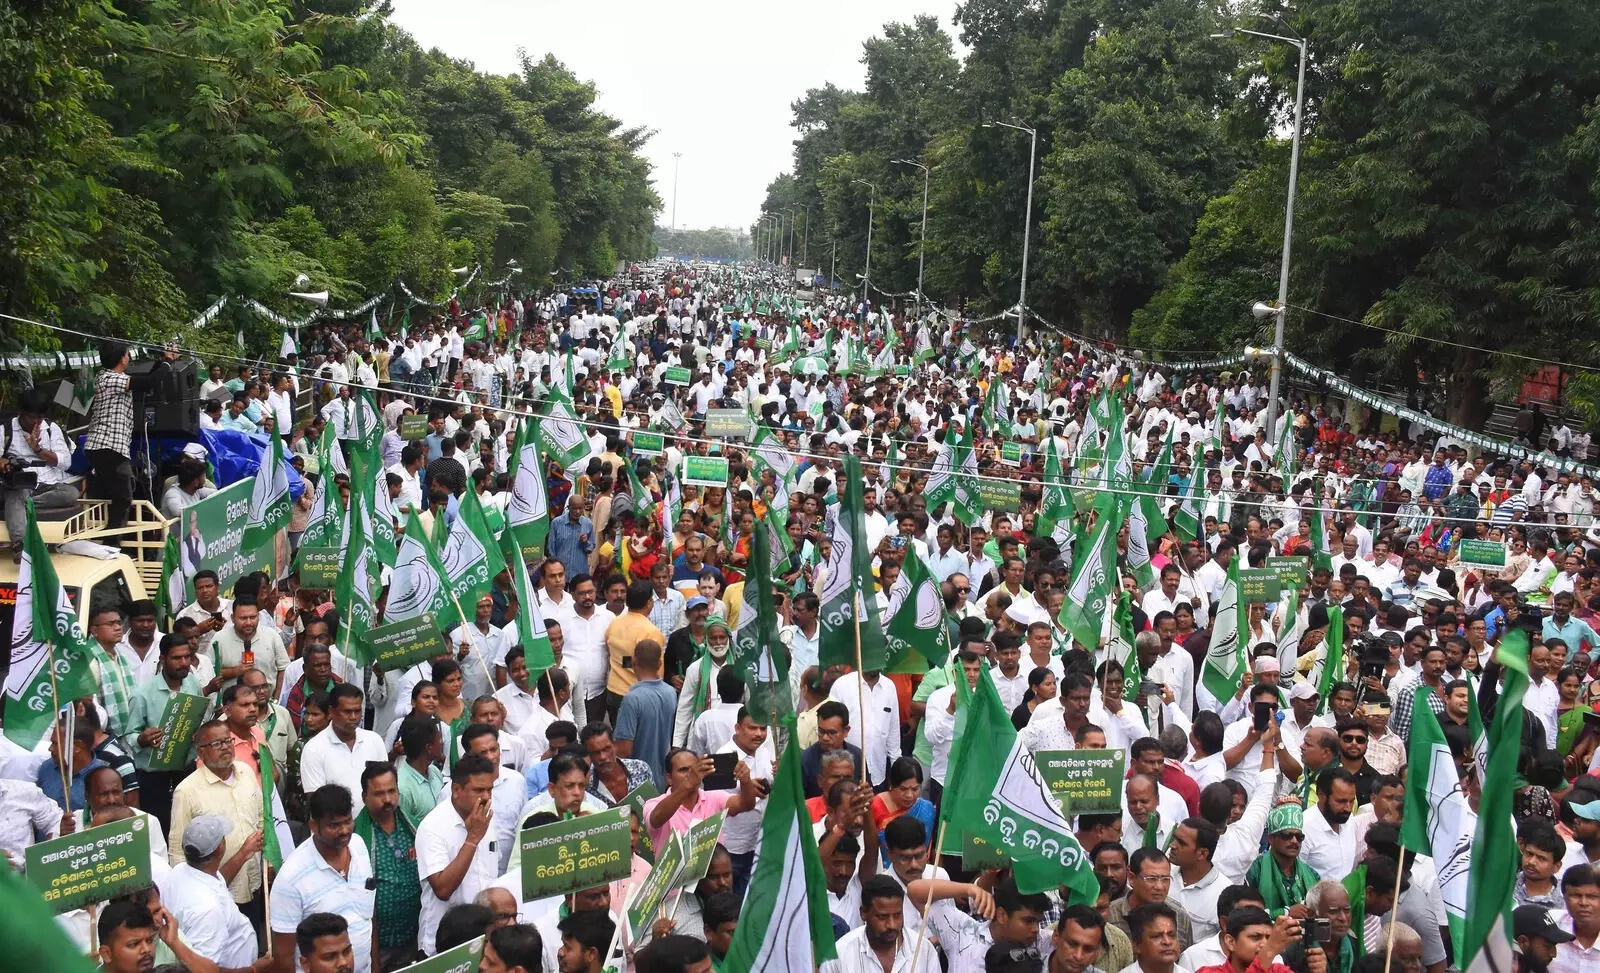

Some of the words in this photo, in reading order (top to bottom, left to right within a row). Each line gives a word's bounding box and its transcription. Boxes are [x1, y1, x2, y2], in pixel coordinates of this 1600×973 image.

[984, 799, 1017, 846] ବିଜୁ
[1023, 829, 1084, 871] ଜନତା
[91, 849, 107, 863] କରି
[96, 857, 126, 874] ବିଜେପି
[536, 859, 575, 878] ବିଜେପି
[578, 850, 620, 869] ସରକାର
